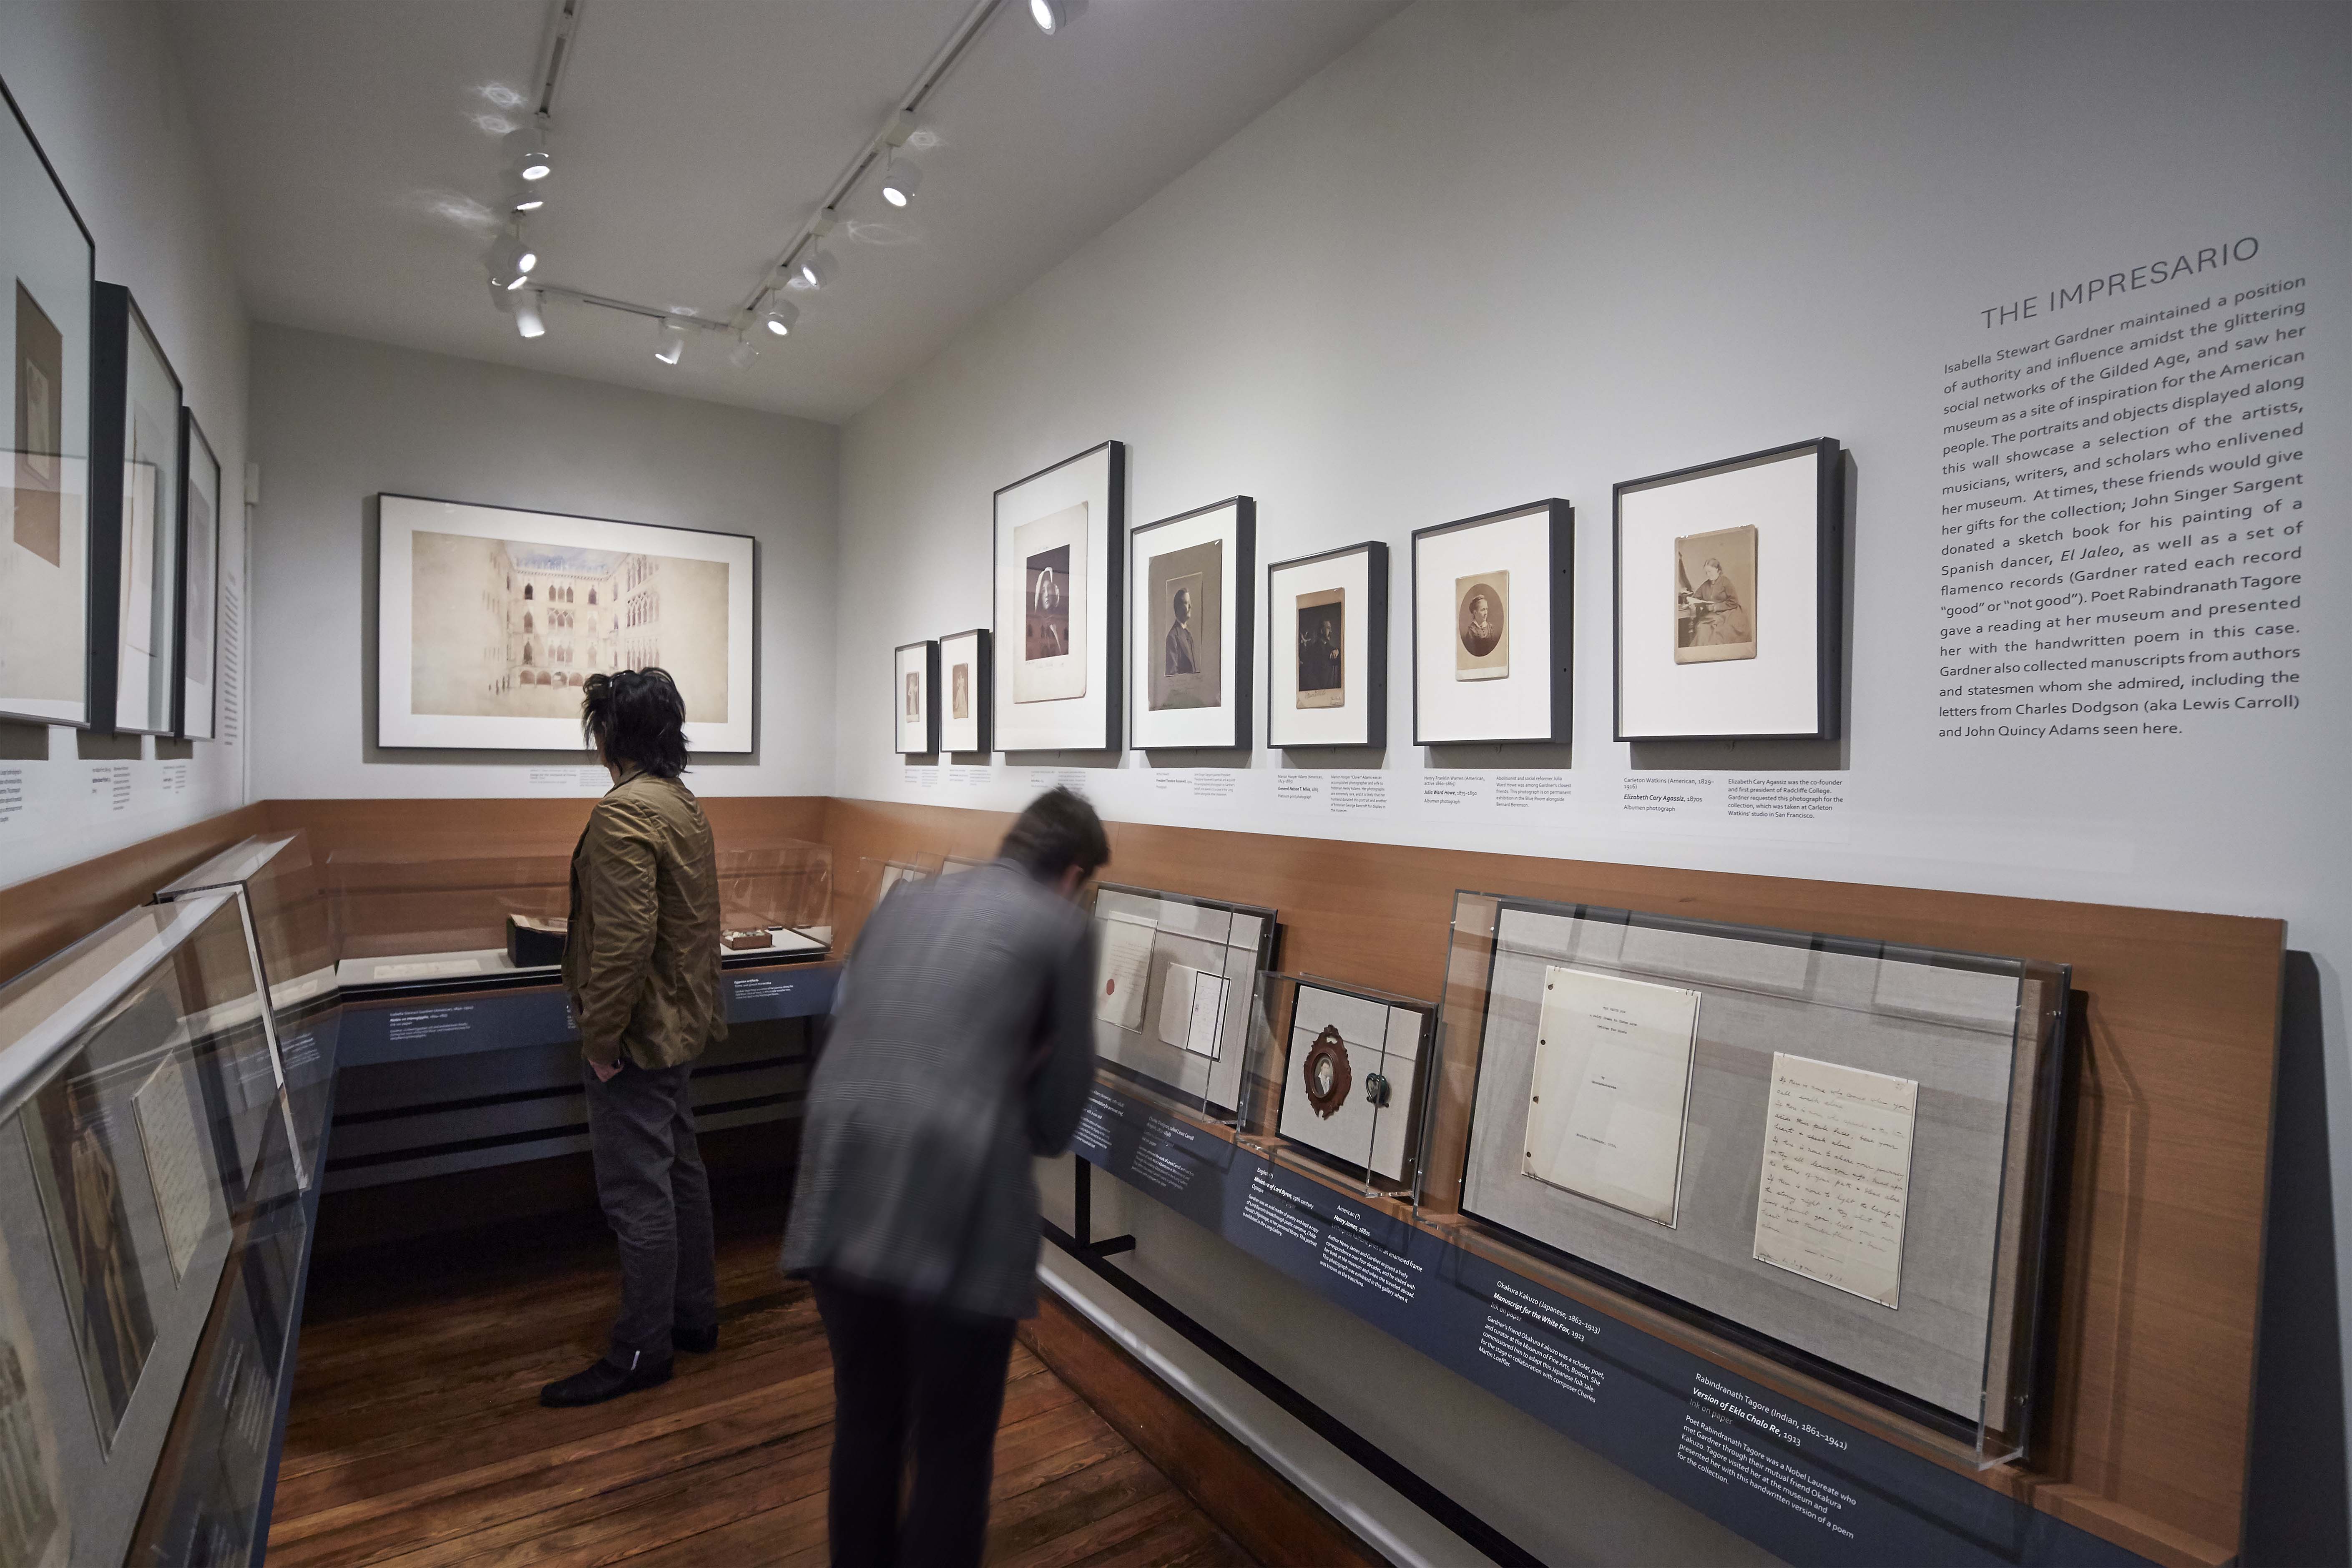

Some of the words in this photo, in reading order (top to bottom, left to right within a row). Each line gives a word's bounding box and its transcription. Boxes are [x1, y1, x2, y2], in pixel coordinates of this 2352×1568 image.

[1980, 296, 2038, 329] THE
[2050, 237, 2259, 312] IMPRESARIO
[1944, 381, 1957, 394] of
[1961, 369, 2021, 390] authority
[2026, 358, 2051, 374] and
[2057, 345, 2124, 367] influence
[2130, 329, 2184, 351] amidst
[2190, 323, 2218, 337] the
[2224, 302, 2305, 332] glittering
[1945, 354, 1991, 374] Isabella
[1997, 339, 2050, 361] Stewart
[2055, 324, 2115, 346] Gardner
[2120, 297, 2210, 331] maintained
[2218, 297, 2227, 307] a
[2235, 277, 2306, 306] position
[1943, 416, 1998, 434] museum
[2002, 412, 2016, 422] as
[2020, 410, 2027, 418] a
[2031, 404, 2055, 416] site
[2059, 396, 2075, 410] of
[2078, 382, 2157, 407] inspiration
[2161, 376, 2186, 389] for
[2189, 369, 2216, 383] the
[2220, 352, 2304, 377] American
[1944, 397, 1979, 415] social
[1984, 384, 2045, 406] networks
[2051, 376, 2066, 390] of
[2070, 373, 2094, 386] the
[2099, 358, 2148, 379] Gilded
[2153, 353, 2190, 369] Age,
[2197, 340, 2228, 358] and
[2235, 334, 2269, 350] saw
[2276, 326, 2306, 342] her
[1943, 438, 1989, 458] people.
[1991, 432, 2016, 445] The
[2020, 420, 2078, 442] portraits
[2082, 411, 2109, 427] and
[2113, 403, 2168, 422] objects
[2172, 383, 2250, 410] displayed
[2255, 376, 2304, 394] along
[1281, 1189, 1292, 1199] Byron,
[1300, 1199, 1314, 1209] century
[1334, 1215, 1346, 1225] Henry
[1345, 1220, 1358, 1231] James,
[1359, 1227, 1370, 1236] 1880s
[1337, 1205, 1355, 1217] American
[1389, 1252, 1410, 1265] enameled
[1410, 1261, 1422, 1272] frame
[1493, 1292, 1523, 1311] Manuscript
[1531, 1311, 1541, 1319] the
[1542, 1315, 1558, 1328] White
[1558, 1324, 1570, 1335] Fox,
[1571, 1331, 1584, 1342] 1913
[1497, 1281, 1518, 1295] Okakura
[1519, 1291, 1538, 1304] Kakuzo
[1539, 1301, 1566, 1319] (Japanese,
[1506, 1312, 1521, 1321] paper
[1689, 1398, 1700, 1410] Ink
[1701, 1406, 1711, 1415] on
[1711, 1411, 1733, 1425] paper
[1693, 1387, 1719, 1405] Version
[1719, 1402, 1730, 1411] of
[1728, 1405, 1745, 1418] Ekla
[1746, 1413, 1768, 1429] Chalo
[1769, 1424, 1781, 1437] Re,
[1783, 1432, 1801, 1447] 1913
[1695, 1373, 1743, 1401] Rabindranath
[1744, 1395, 1770, 1413] Tagore
[1771, 1409, 1799, 1429] (Indian,
